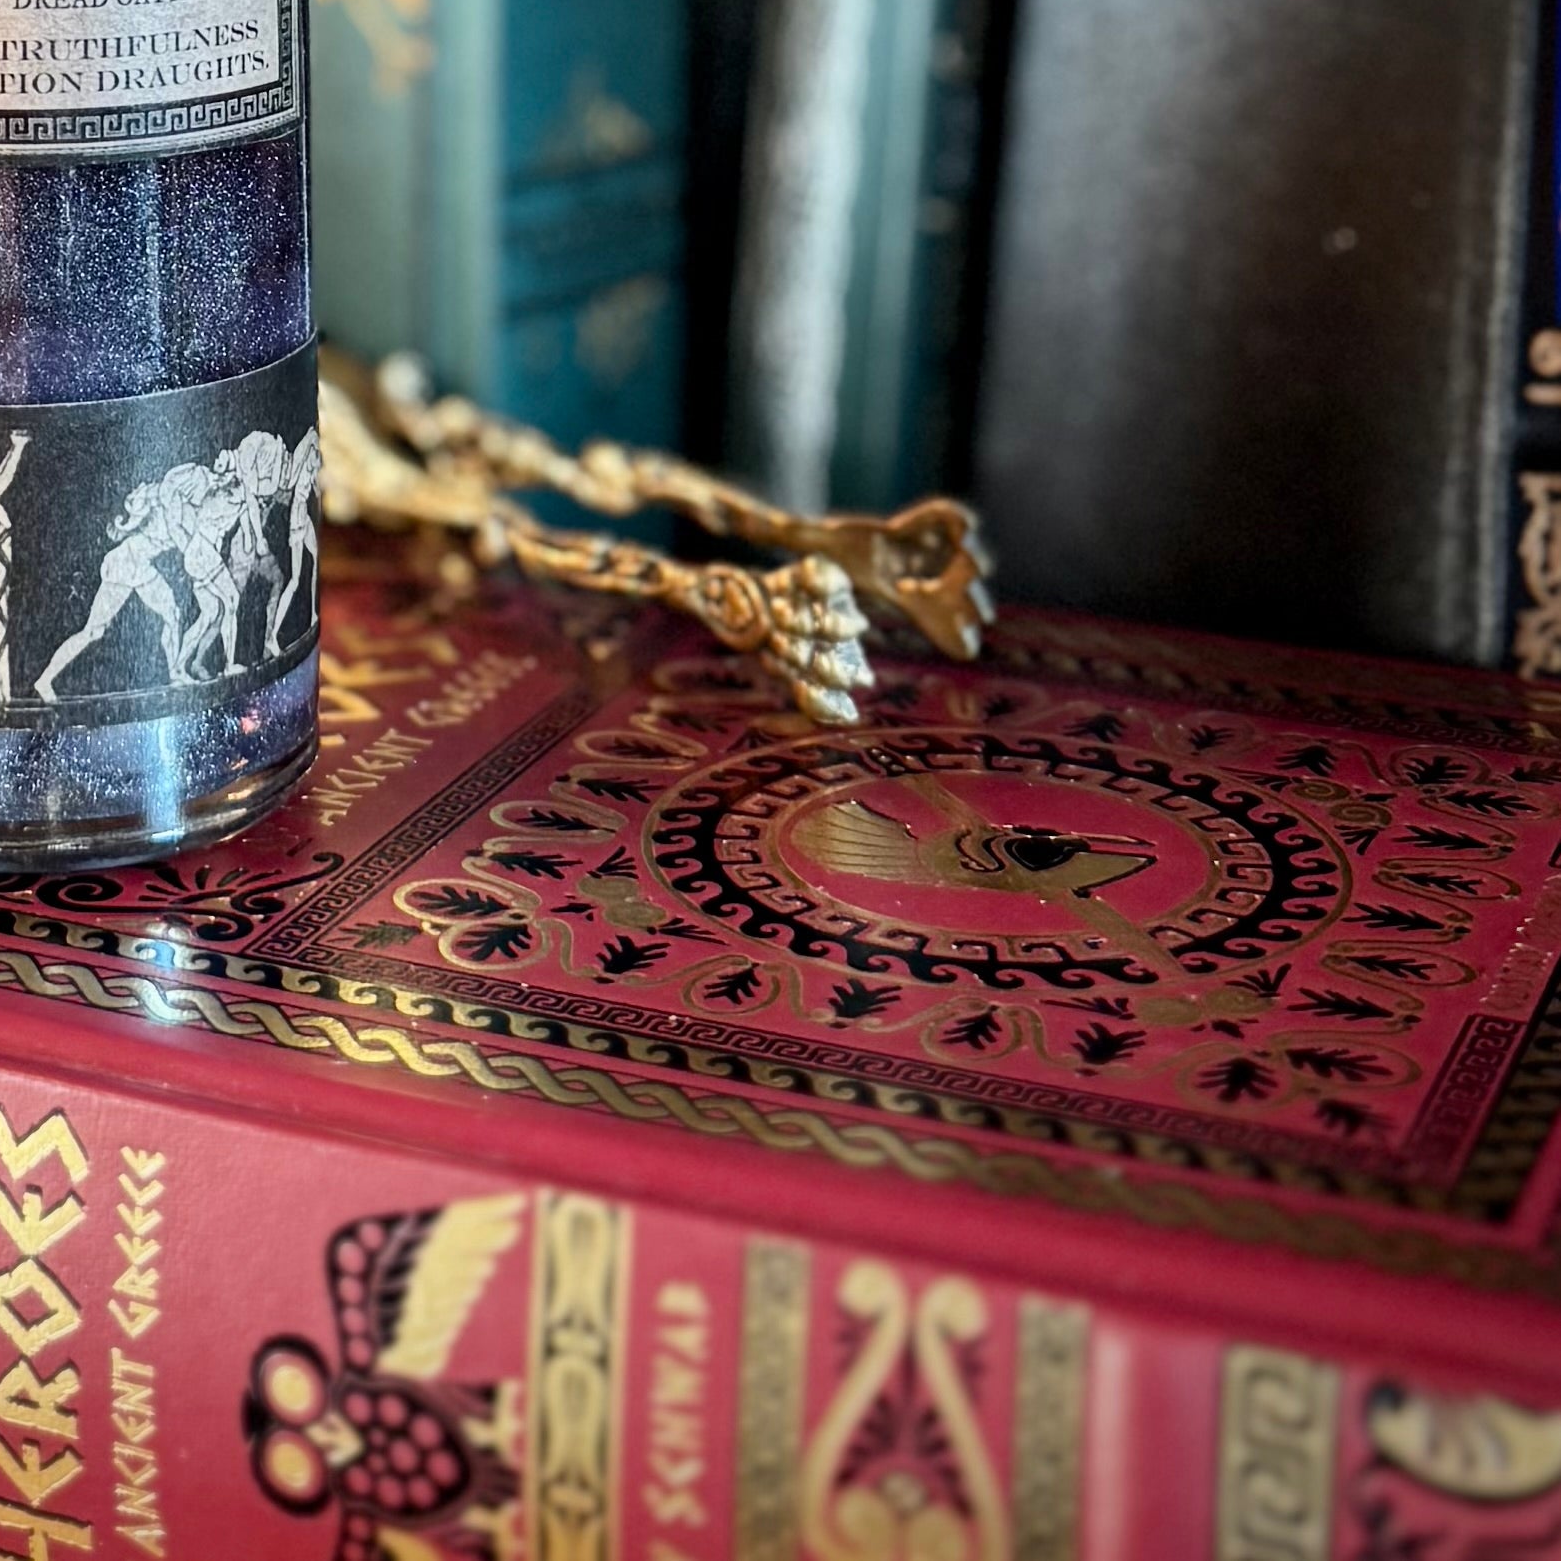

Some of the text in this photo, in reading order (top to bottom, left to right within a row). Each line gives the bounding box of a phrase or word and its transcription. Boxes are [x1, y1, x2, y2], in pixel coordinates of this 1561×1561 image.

[97, 50, 270, 92] DRAUGHTS.
[108, 1145, 168, 1558] ANCIENT GREECE
[643, 1280, 710, 1529] SCHWAB
